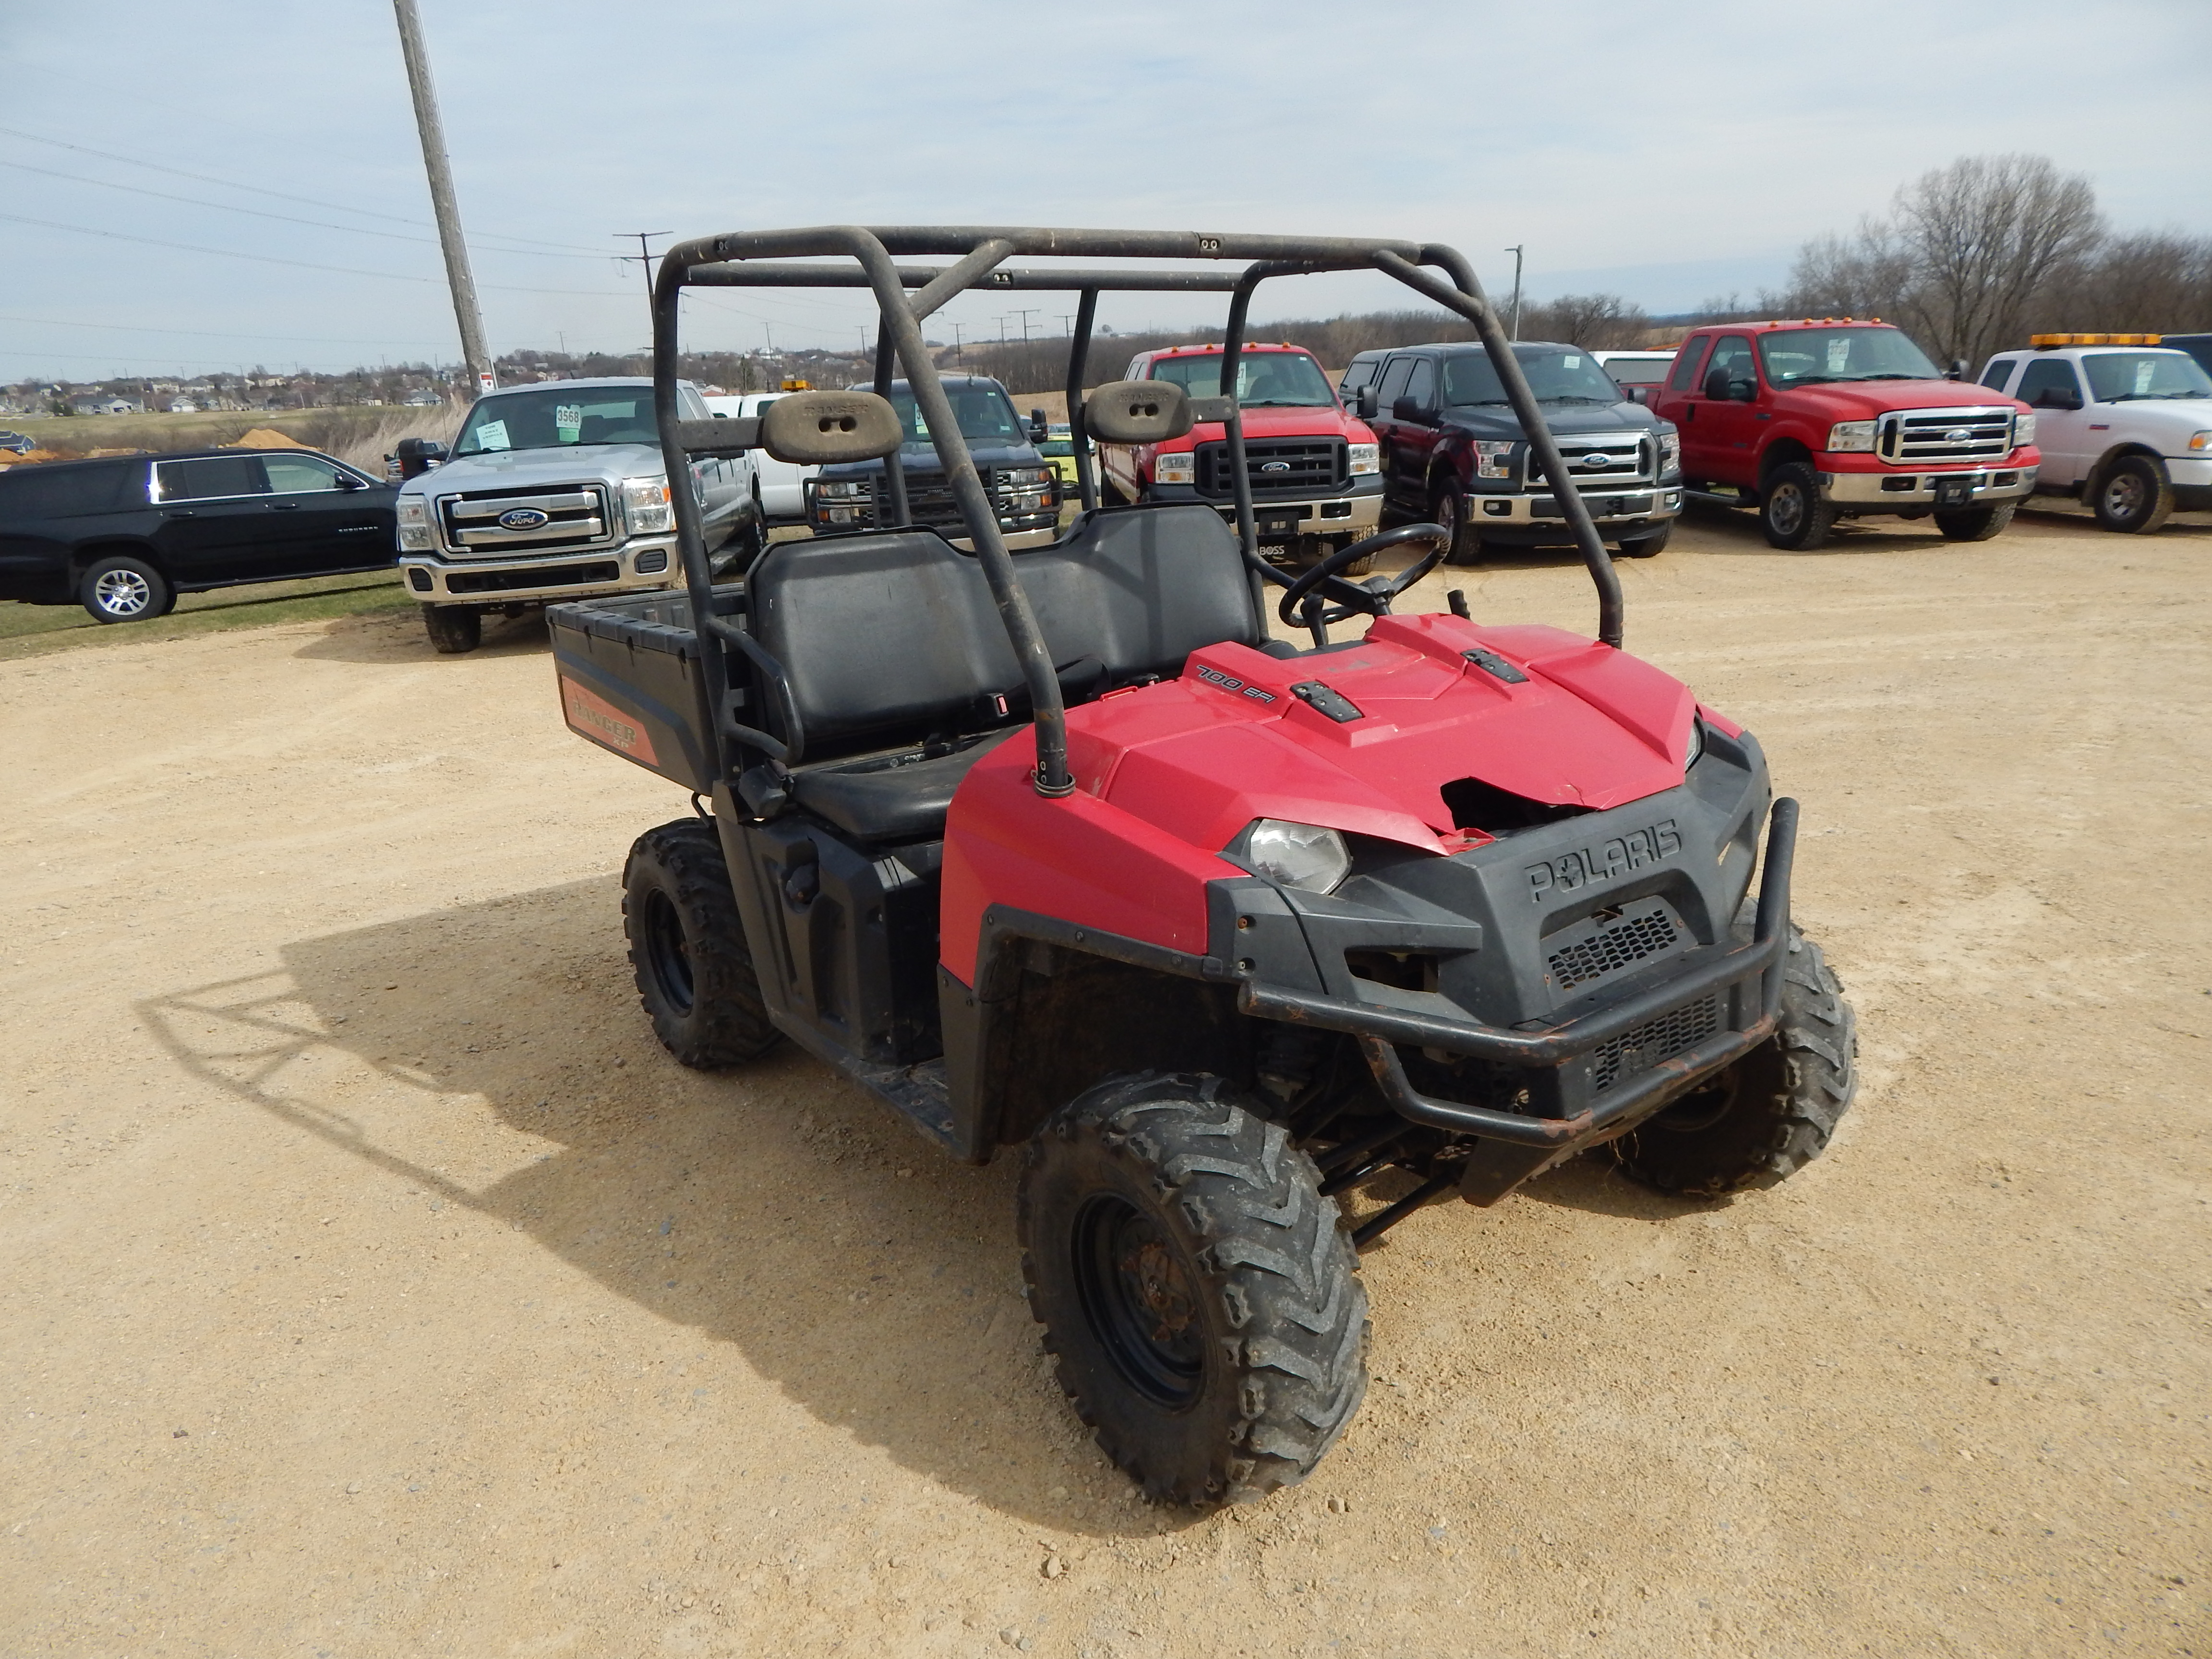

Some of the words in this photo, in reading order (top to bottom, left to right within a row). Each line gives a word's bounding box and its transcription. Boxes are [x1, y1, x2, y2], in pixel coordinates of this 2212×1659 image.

[558, 409, 579, 423] 3568
[509, 512, 536, 525] Ford
[1259, 545, 1285, 556] BOSS
[1196, 664, 1244, 691] 700
[1242, 685, 1278, 704] EFI
[573, 699, 637, 745] RANGER
[613, 736, 629, 748] XP
[1524, 818, 1683, 904] POLARIS
